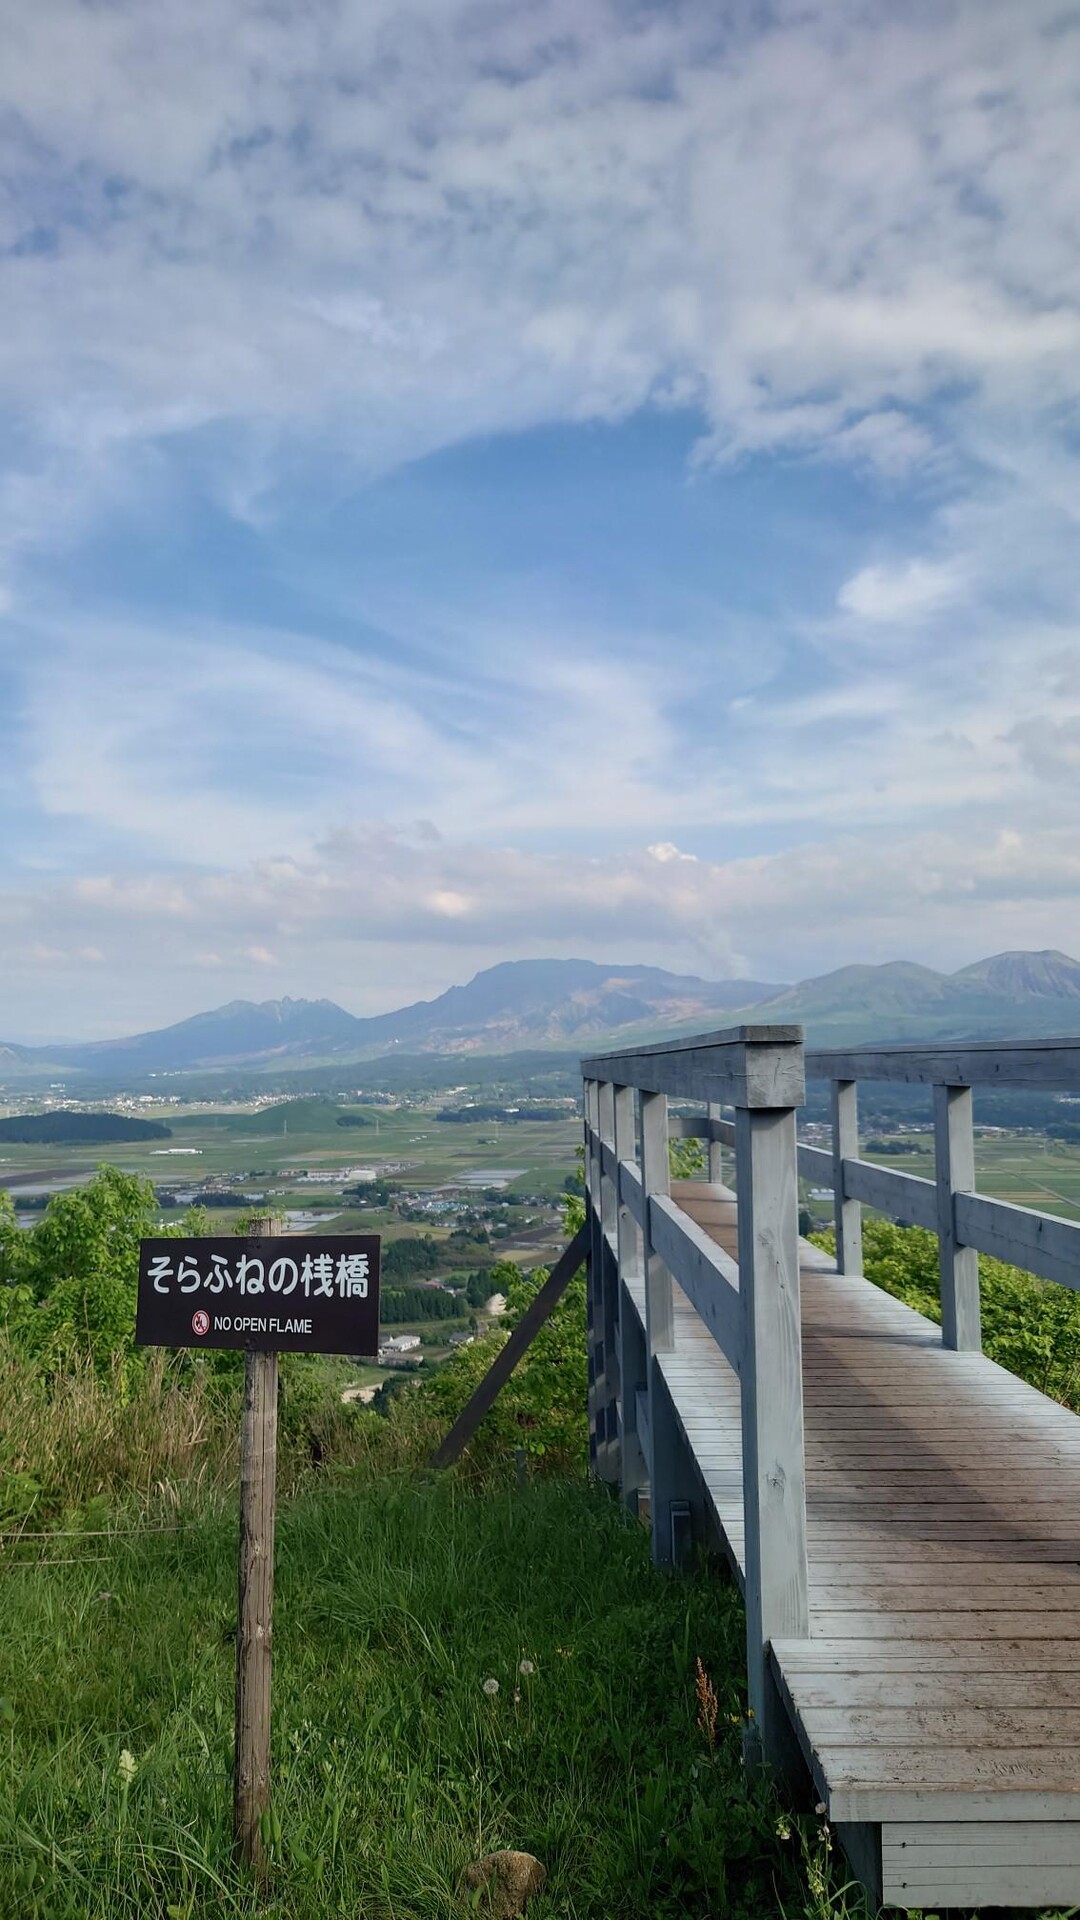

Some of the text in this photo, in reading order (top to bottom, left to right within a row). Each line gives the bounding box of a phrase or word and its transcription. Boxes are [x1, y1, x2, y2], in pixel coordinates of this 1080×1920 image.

[147, 1253, 369, 1298] そらふねの桟橋
[214, 1316, 312, 1334] NO OPEN FLAME
